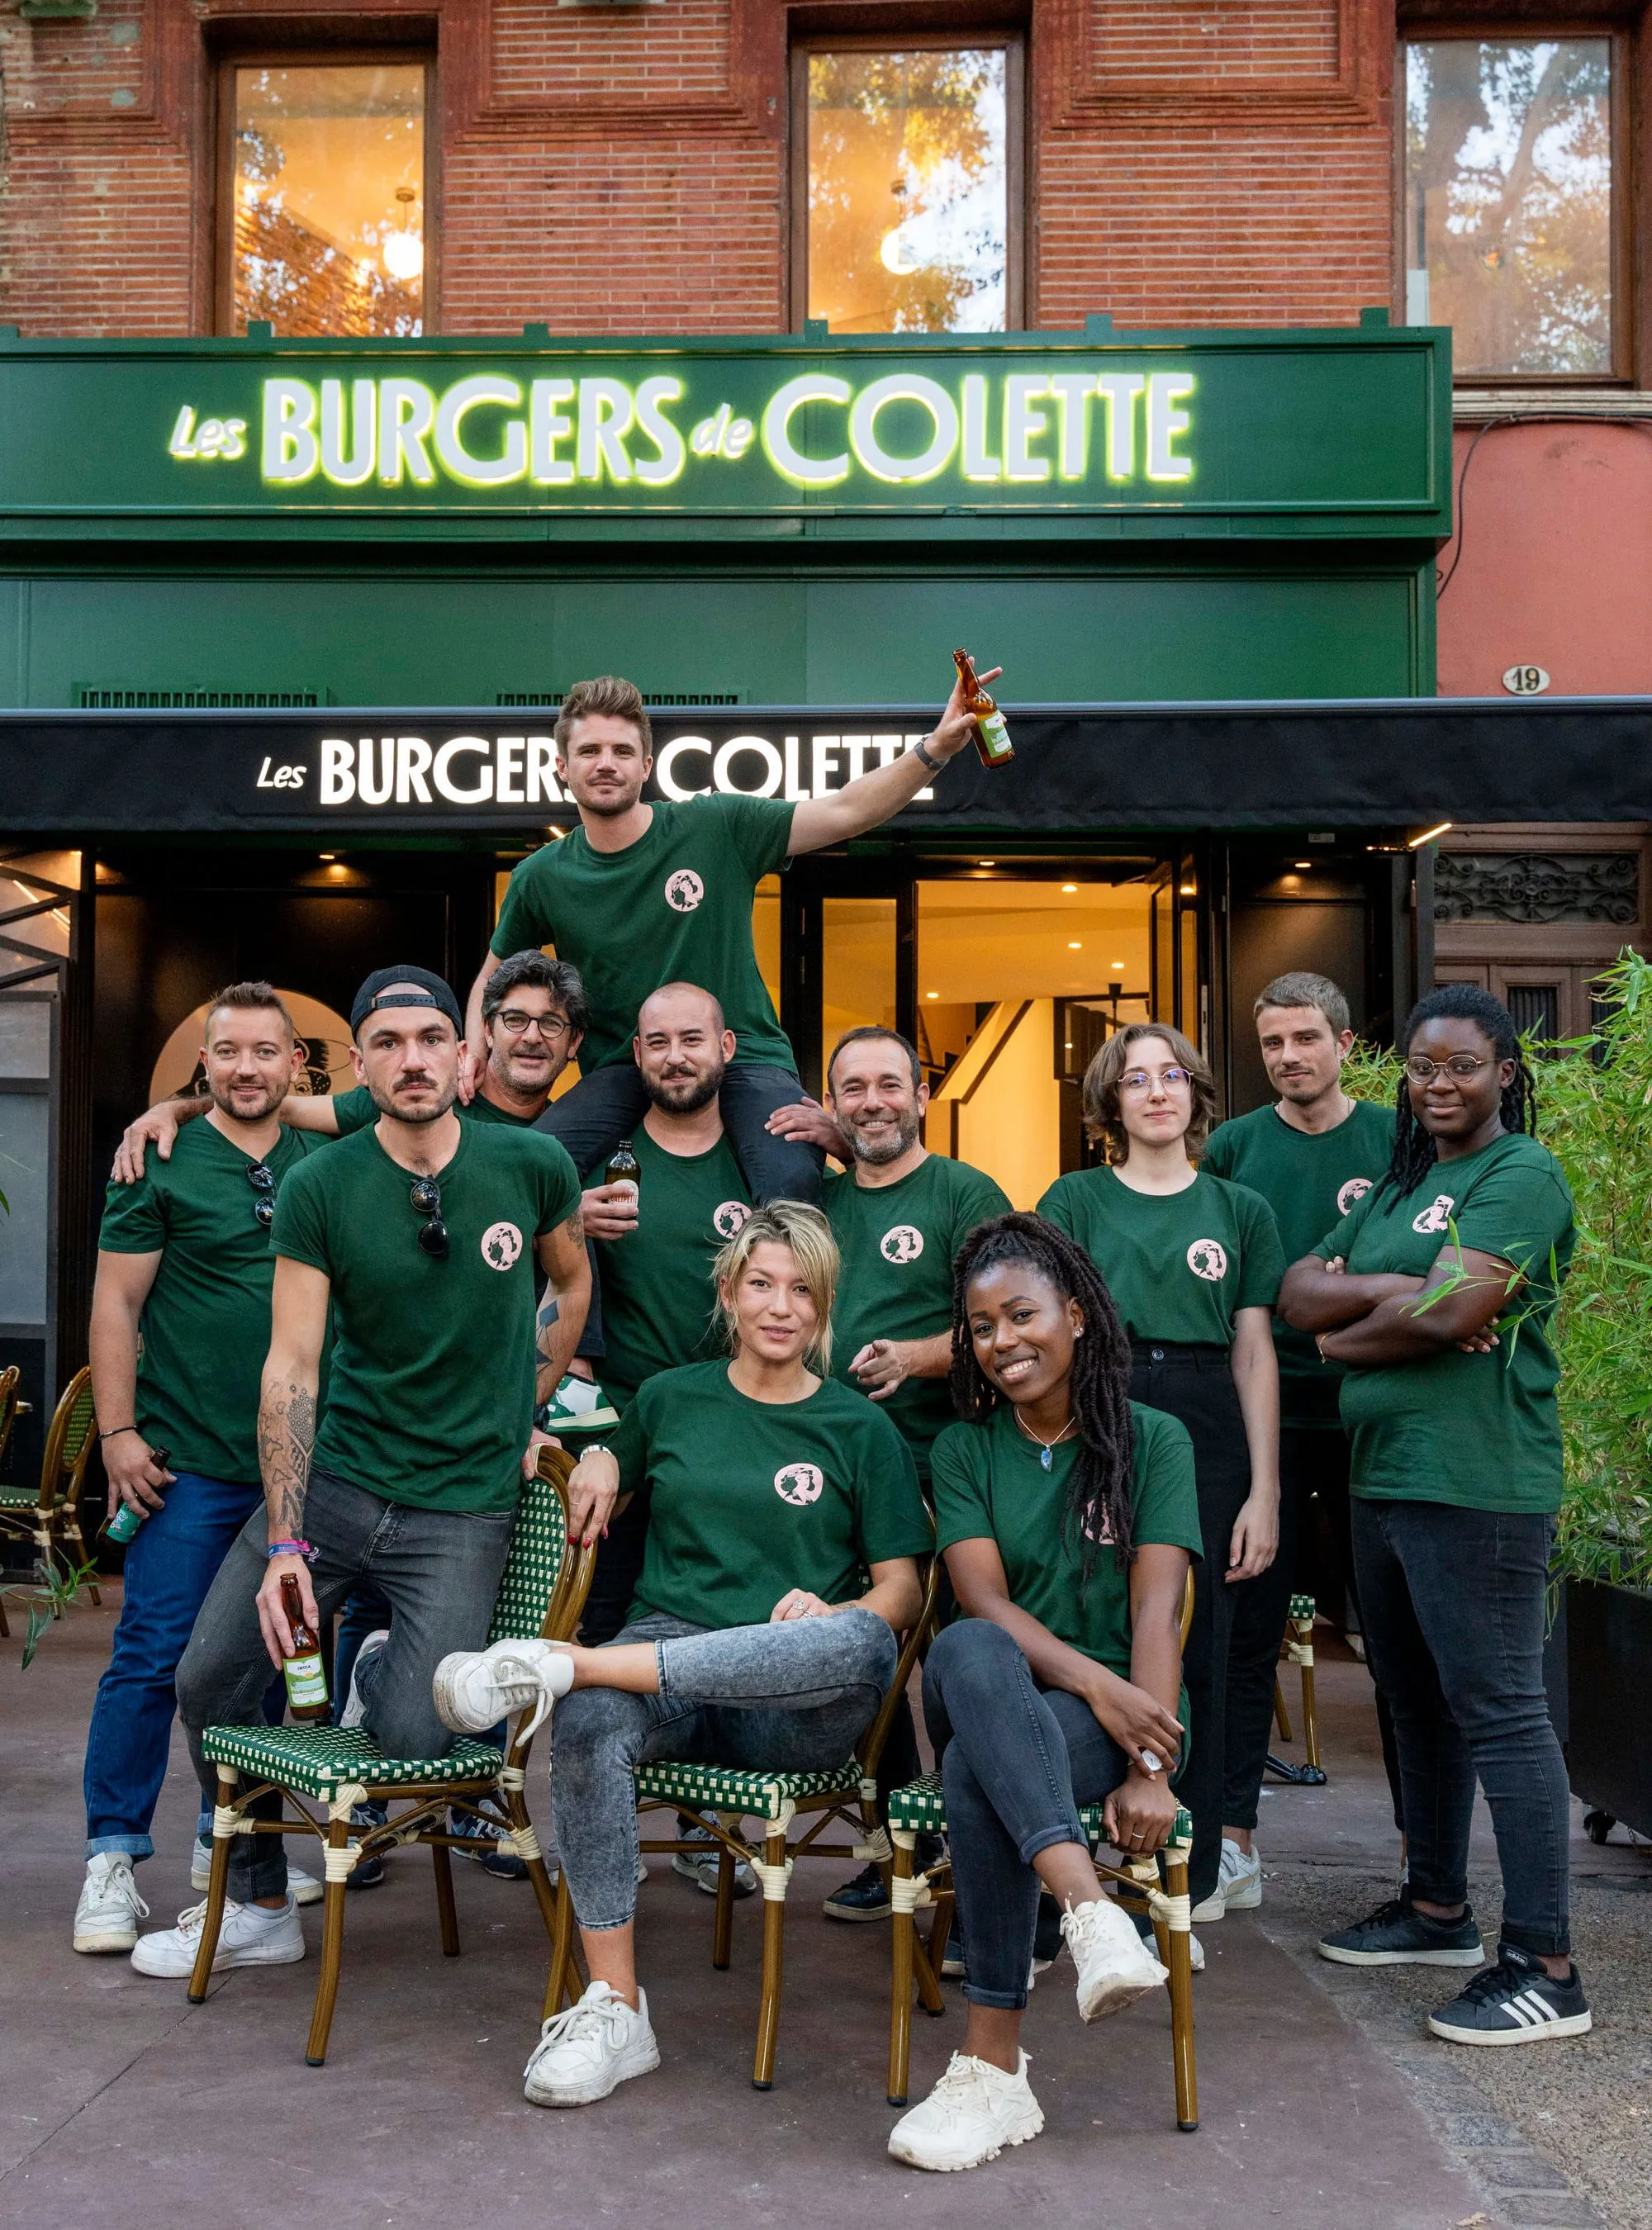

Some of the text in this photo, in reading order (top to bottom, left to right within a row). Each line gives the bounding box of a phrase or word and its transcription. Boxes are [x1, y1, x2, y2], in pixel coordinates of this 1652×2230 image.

[170, 372, 1194, 485] Les BURGERS de COLETTE
[1512, 667, 1540, 691] 19
[256, 756, 307, 790] Les
[319, 736, 577, 805] BURGER
